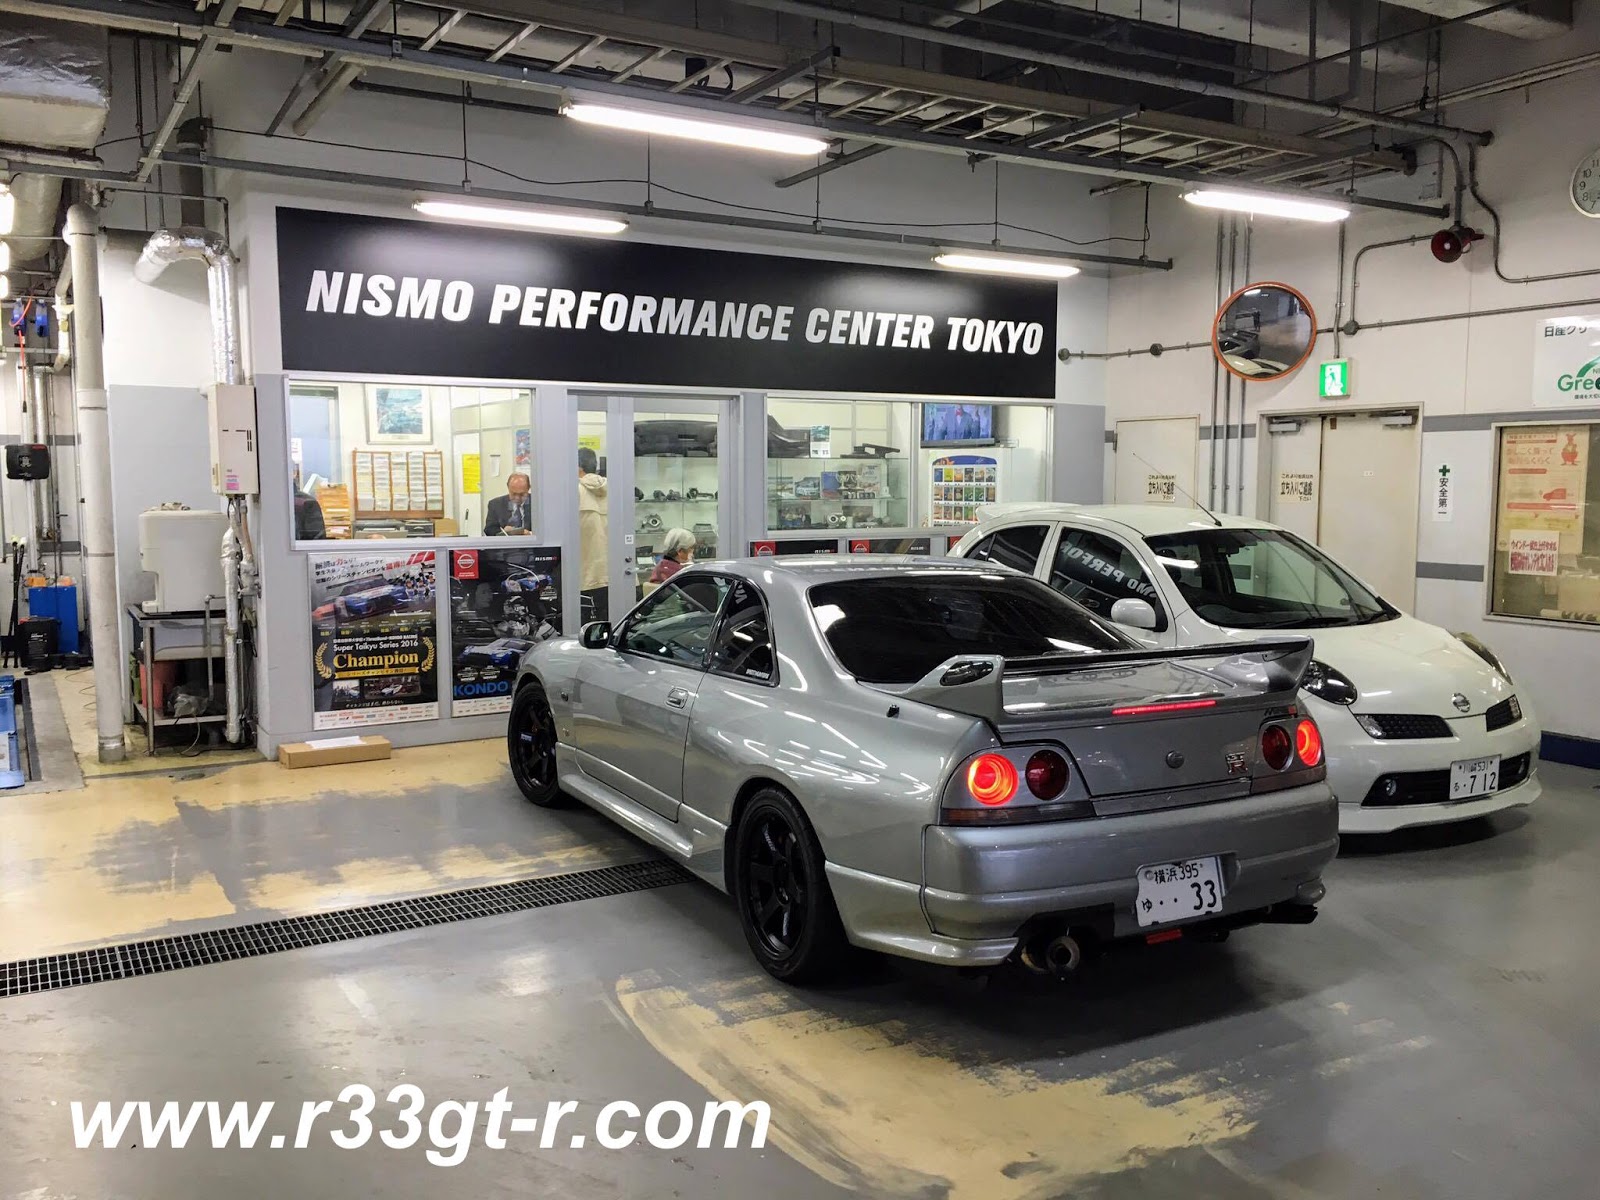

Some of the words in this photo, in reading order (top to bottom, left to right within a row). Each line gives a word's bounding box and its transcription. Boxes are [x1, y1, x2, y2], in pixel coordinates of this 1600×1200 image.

[1583, 168, 1592, 178] 10
[1579, 181, 1586, 190] 9
[1582, 191, 1588, 201] 8
[306, 269, 474, 323] NISMO
[488, 283, 795, 342] PERFORMANCE
[804, 307, 935, 350] CENTER
[946, 316, 1044, 356] TOKYO
[1437, 477, 1449, 515] 安全第一
[333, 644, 353, 653] Super
[355, 642, 378, 652] Taikyu
[379, 641, 399, 649] Series
[400, 640, 419, 648] 2016
[332, 650, 419, 669] Champion
[453, 681, 509, 697] KONDO
[1141, 898, 1153, 914] ゆ
